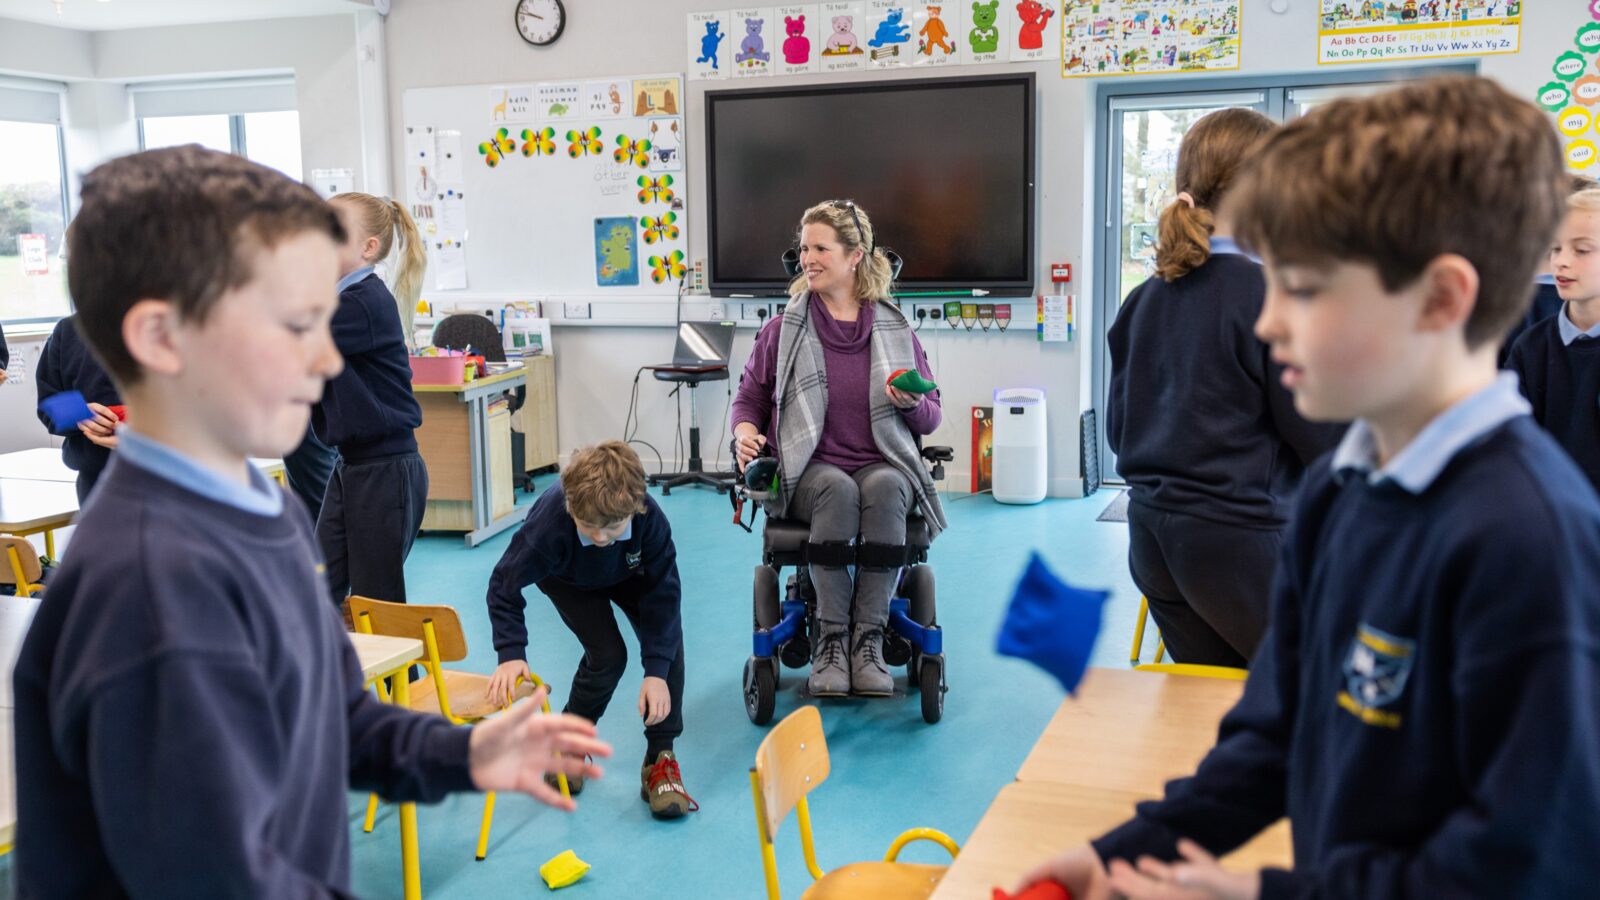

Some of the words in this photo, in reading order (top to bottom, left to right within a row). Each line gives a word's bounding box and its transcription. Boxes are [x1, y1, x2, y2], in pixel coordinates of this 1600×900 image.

[1331, 37, 1342, 46] Aa
[1345, 37, 1356, 45] Bb
[1359, 36, 1370, 44] Cc
[1372, 35, 1384, 43] Dd
[1386, 34, 1396, 42] Ee
[1410, 33, 1423, 43] Gg
[1425, 31, 1437, 40] Hh
[1460, 29, 1471, 38] Kk
[1327, 50, 1339, 58] Nn
[1342, 49, 1353, 57] Oo
[1357, 48, 1367, 58] Pp
[1370, 47, 1383, 57] Qq
[1386, 46, 1395, 54] Rr
[1398, 46, 1407, 54] Ss
[1410, 45, 1419, 53] Tt
[1421, 44, 1434, 52] Uu
[1437, 43, 1449, 51] Vv
[1451, 42, 1469, 50] Ww
[1472, 41, 1483, 49] Xx
[1486, 40, 1497, 49] Yy
[1500, 39, 1510, 48] Zz
[1559, 62, 1580, 71] where
[1545, 92, 1562, 101] who
[1568, 119, 1582, 127] my
[1573, 149, 1589, 158] said
[658, 783, 685, 795] PUMA
